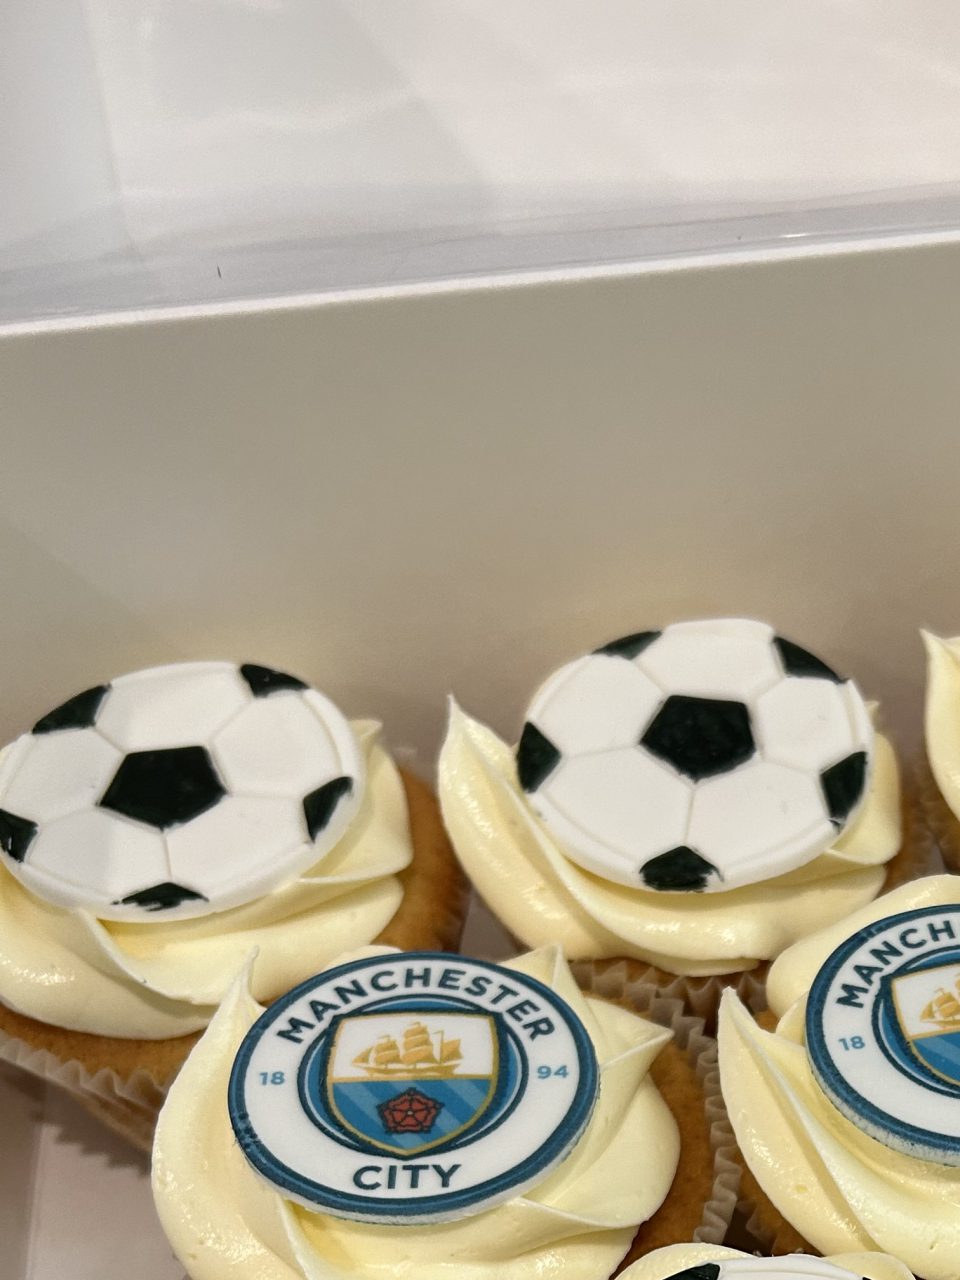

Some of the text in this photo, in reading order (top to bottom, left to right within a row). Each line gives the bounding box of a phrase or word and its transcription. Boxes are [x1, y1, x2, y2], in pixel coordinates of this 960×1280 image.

[276, 967, 556, 1044] MANCHESTER
[838, 1035, 866, 1051] 18
[259, 1071, 286, 1086] 18
[536, 1065, 569, 1080] 94
[352, 1163, 462, 1191] CITY
